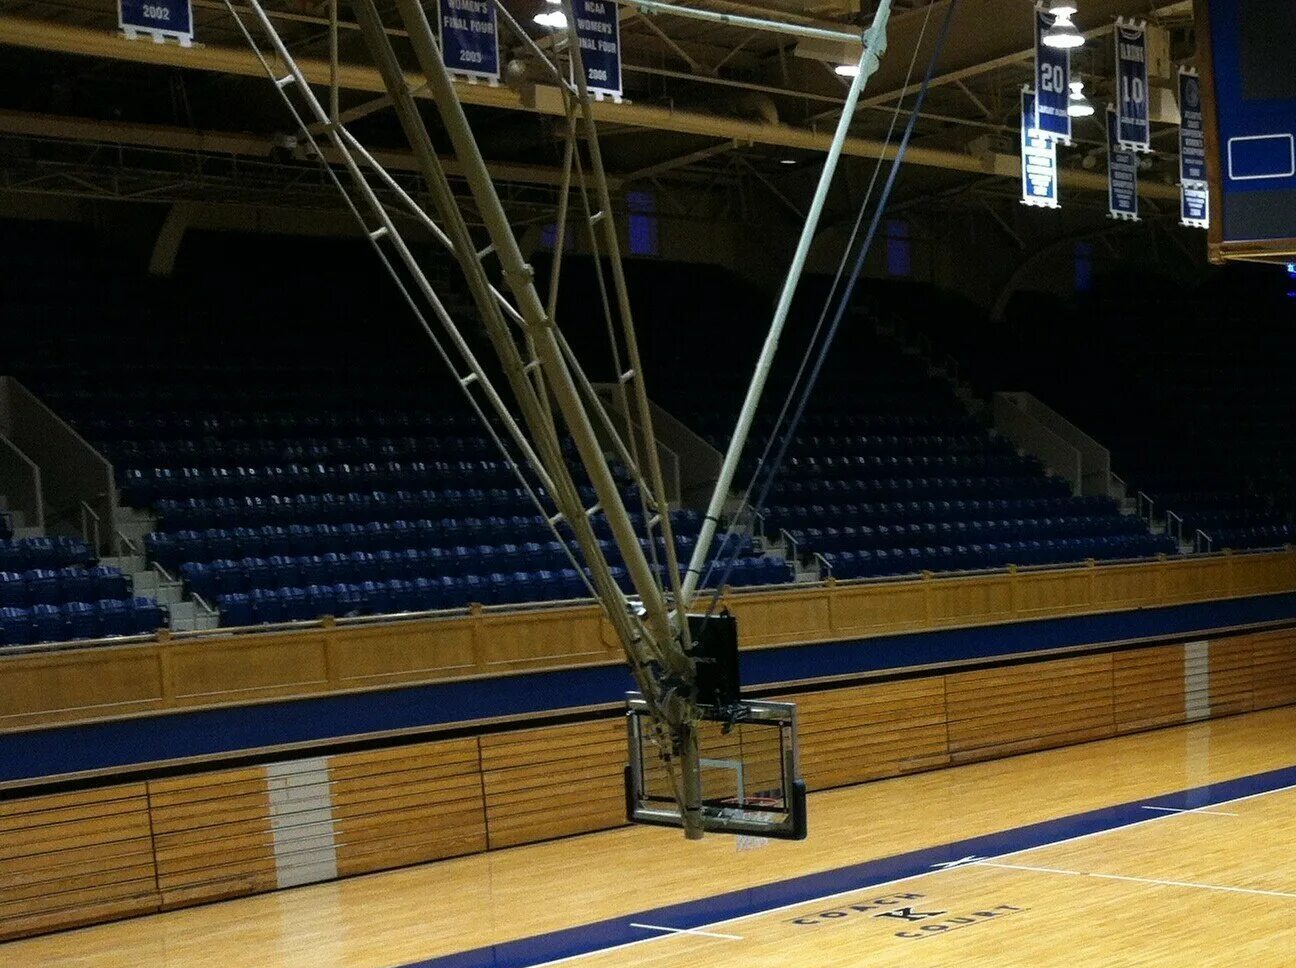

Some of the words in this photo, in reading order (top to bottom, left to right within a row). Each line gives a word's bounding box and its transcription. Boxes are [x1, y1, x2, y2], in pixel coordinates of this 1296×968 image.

[143, 4, 170, 20] 2002
[1041, 62, 1064, 94] 20
[1122, 75, 1143, 103] 10
[791, 892, 926, 926] COACH
[873, 906, 948, 922] K
[894, 904, 1020, 940] COURT
